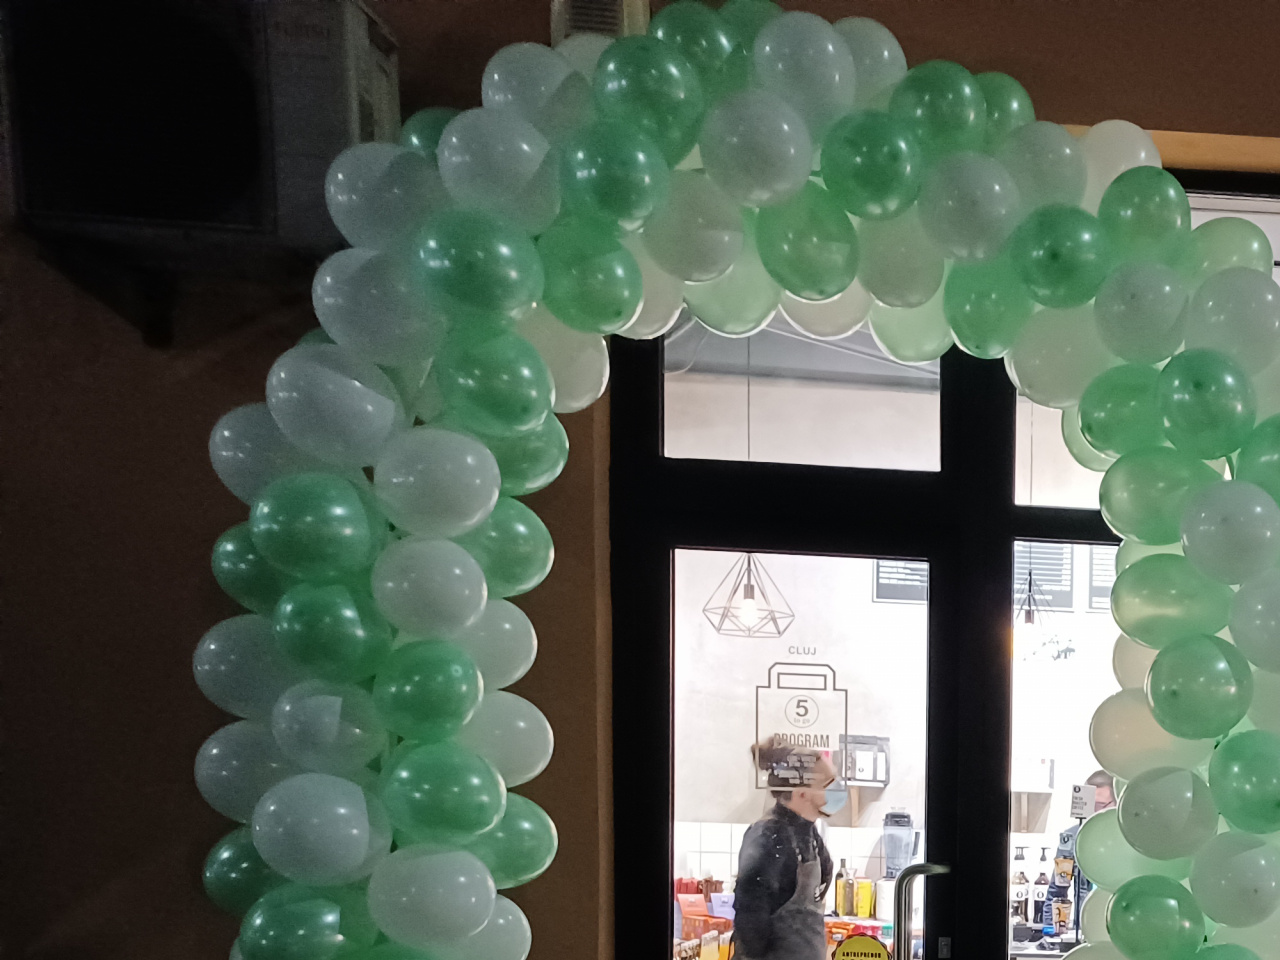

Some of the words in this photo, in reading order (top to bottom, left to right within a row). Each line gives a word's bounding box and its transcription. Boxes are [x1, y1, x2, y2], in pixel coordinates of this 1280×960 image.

[788, 646, 816, 656] CLUJ
[795, 699, 809, 717] 5
[774, 732, 829, 748] PROGRAM
